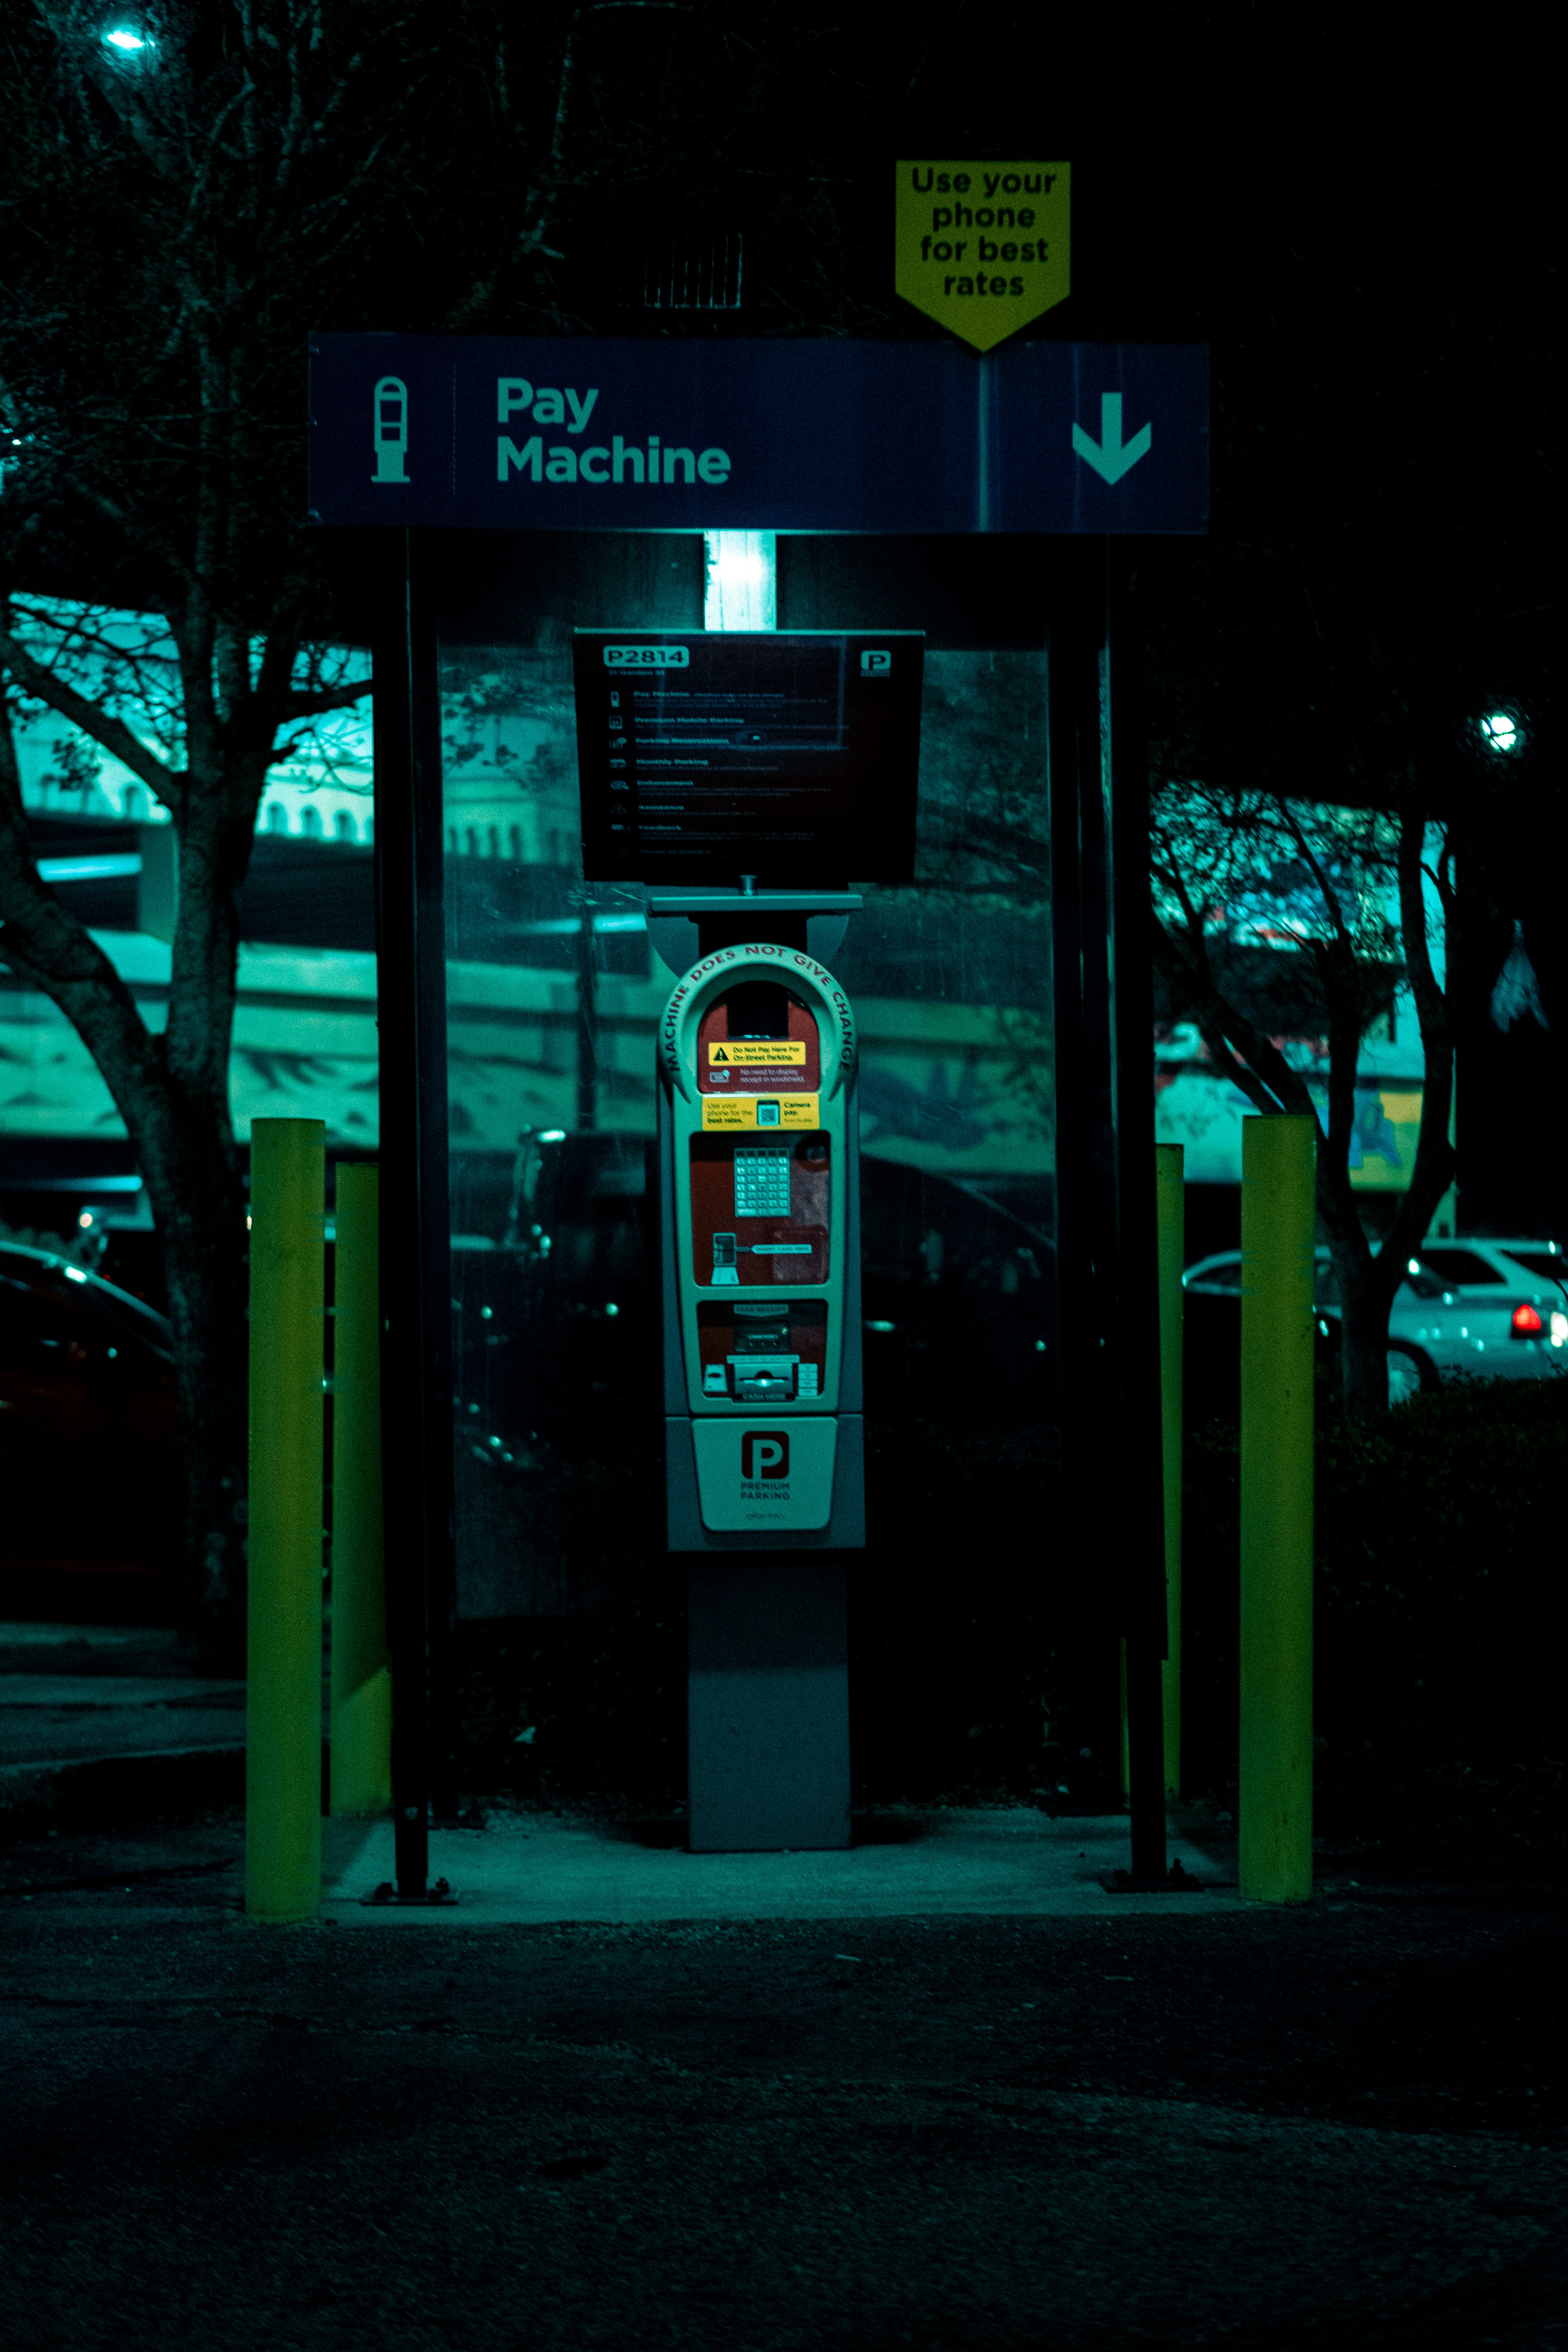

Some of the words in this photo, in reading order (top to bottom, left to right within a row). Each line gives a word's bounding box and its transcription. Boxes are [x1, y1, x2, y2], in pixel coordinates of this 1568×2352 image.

[913, 167, 971, 193] Use
[984, 173, 1056, 199] your
[933, 201, 1036, 232] phone
[921, 236, 967, 261] for
[980, 236, 1048, 262] best
[945, 272, 1024, 296] rates
[497, 377, 599, 434] Pay
[497, 436, 731, 484] Machine
[608, 650, 684, 663] P2814
[869, 655, 885, 669] P
[665, 985, 689, 1072] MACHINE
[690, 951, 735, 981] DOES
[745, 946, 787, 957] NOT
[794, 955, 831, 986] GIVE
[833, 992, 853, 1070] CHANGE
[752, 1439, 784, 1479] P
[740, 1491, 790, 1500] PARKING
